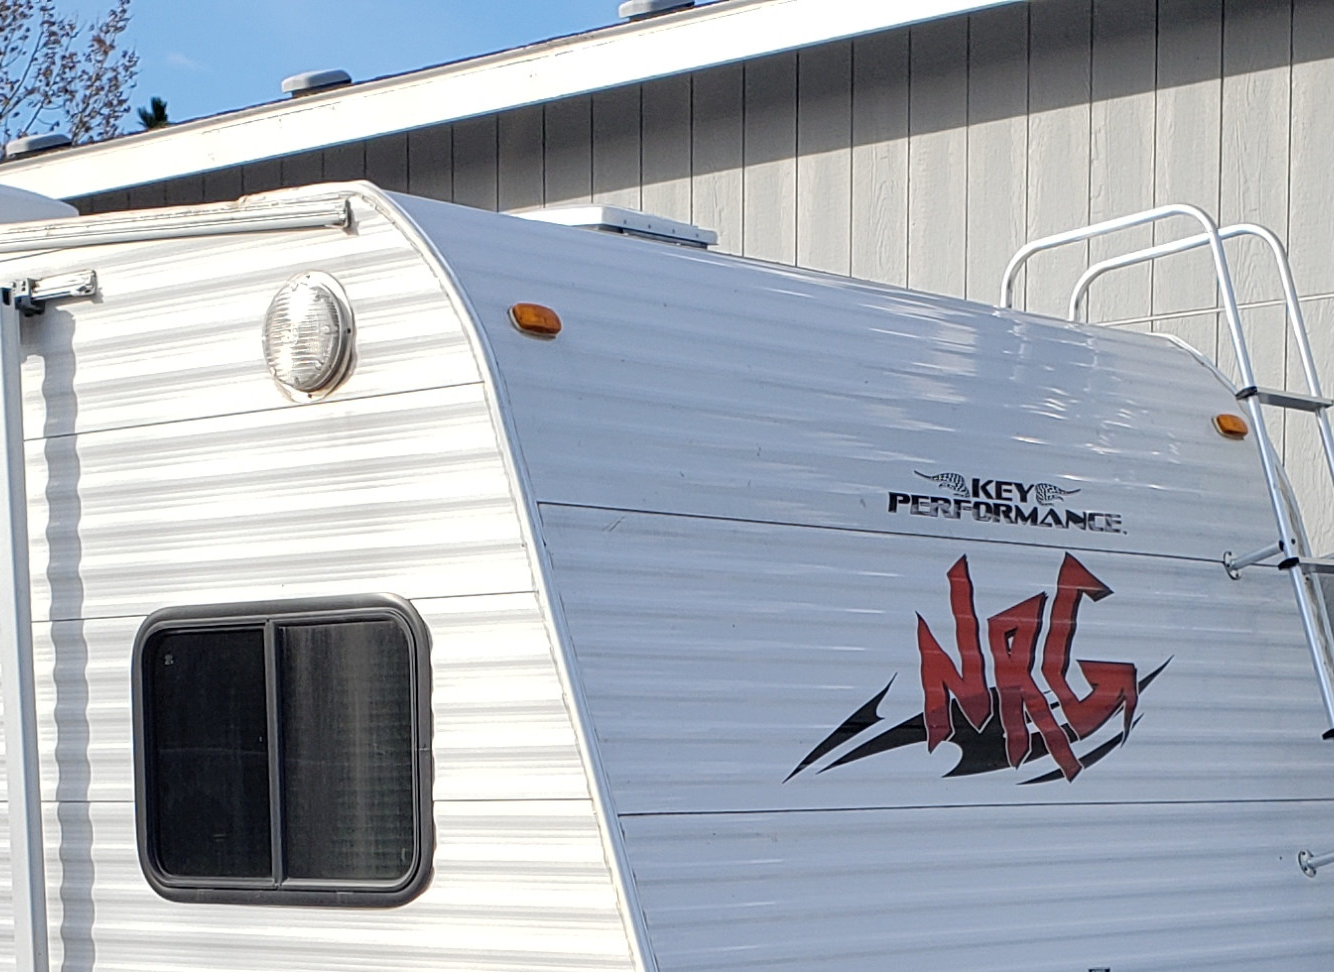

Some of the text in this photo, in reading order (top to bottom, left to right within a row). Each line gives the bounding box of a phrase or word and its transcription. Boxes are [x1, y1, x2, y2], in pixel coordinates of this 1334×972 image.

[970, 477, 1036, 502] KEY
[887, 491, 1123, 534] PERFORMANCE
[914, 550, 1139, 783] NRG
